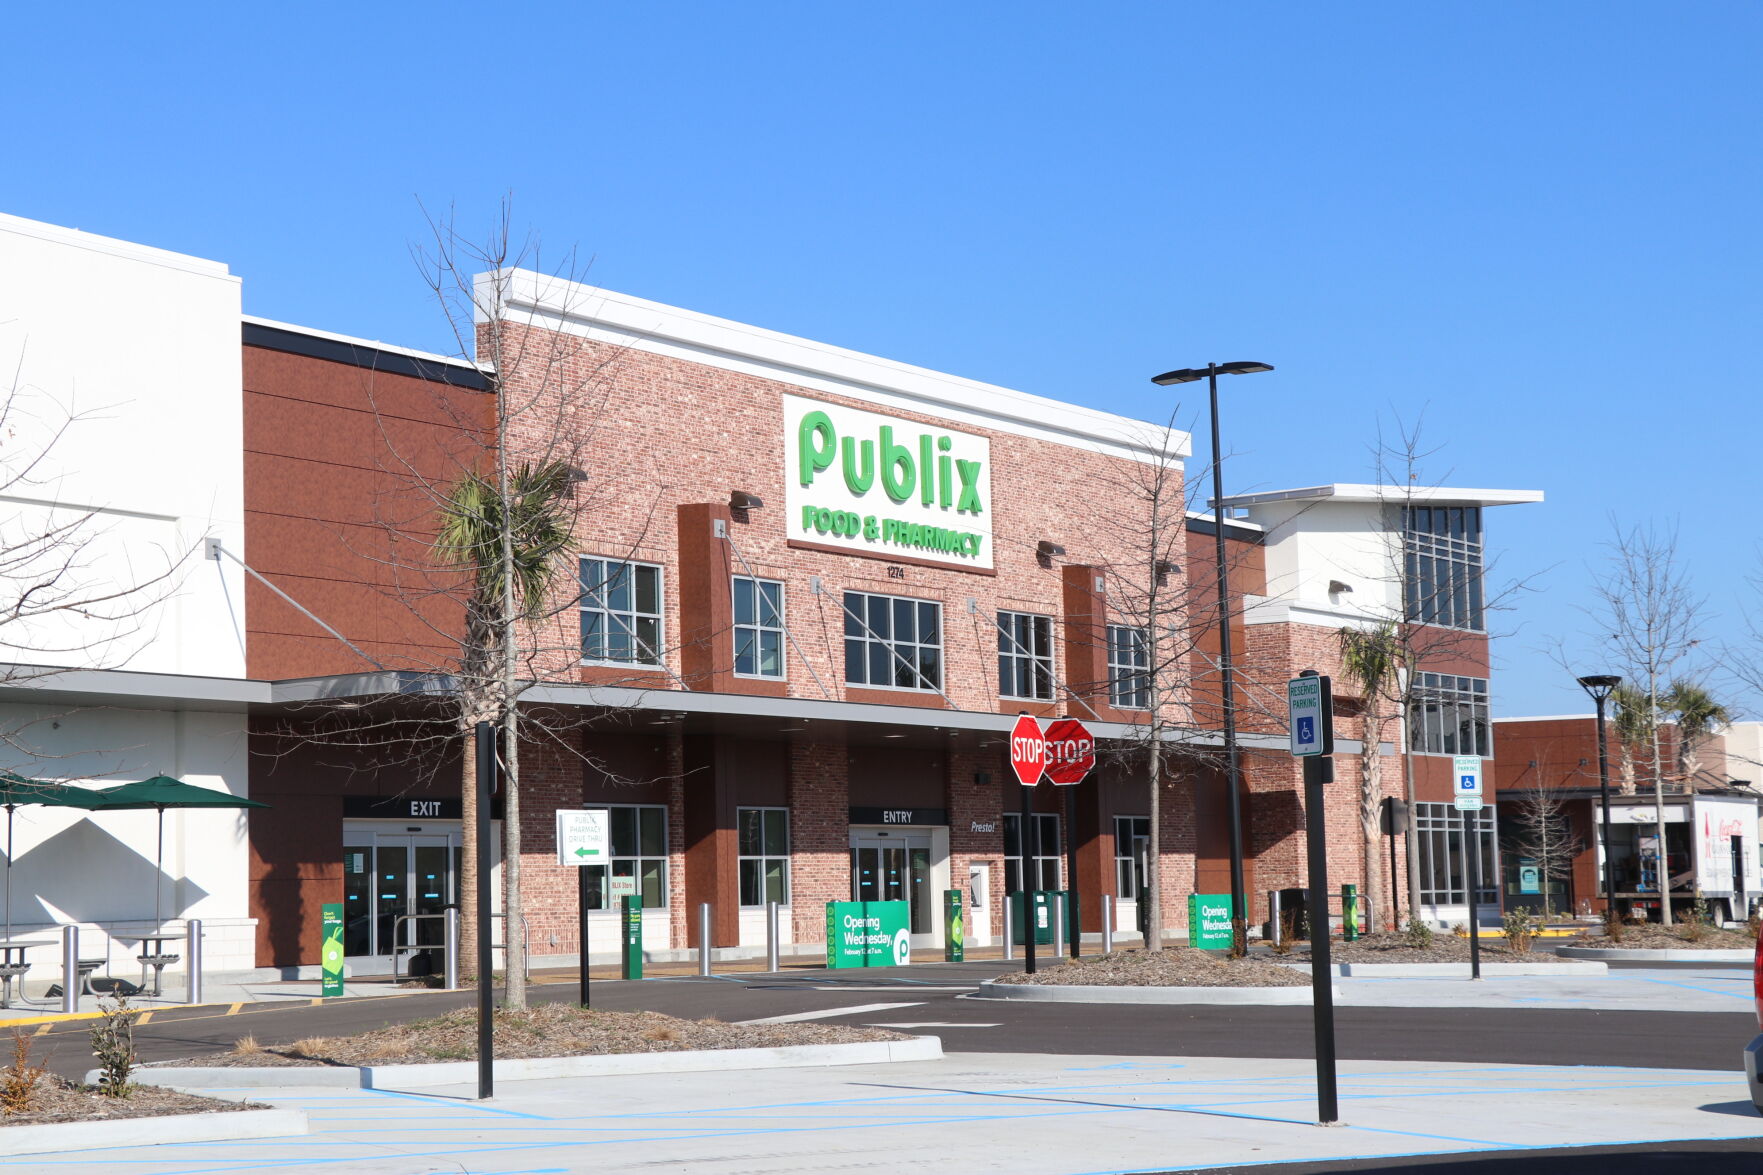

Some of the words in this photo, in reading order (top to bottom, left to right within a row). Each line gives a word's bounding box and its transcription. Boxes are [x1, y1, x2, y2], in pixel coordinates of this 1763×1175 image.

[798, 410, 983, 513] Publix
[802, 505, 861, 536] FOOD
[863, 515, 880, 539] &
[882, 518, 983, 556] PHARMACY
[887, 566, 904, 580] 1274
[1290, 684, 1318, 697] RESERVED
[1293, 698, 1317, 710] PARKING
[1013, 736, 1043, 763] STOP
[1045, 739, 1091, 765] STOP
[410, 800, 441, 817] EXIT
[883, 811, 912, 823] ENTRY
[971, 821, 995, 833] Presto!
[1202, 905, 1227, 919] Opening
[844, 914, 880, 931] Opening
[844, 931, 893, 947] Wednesday,
